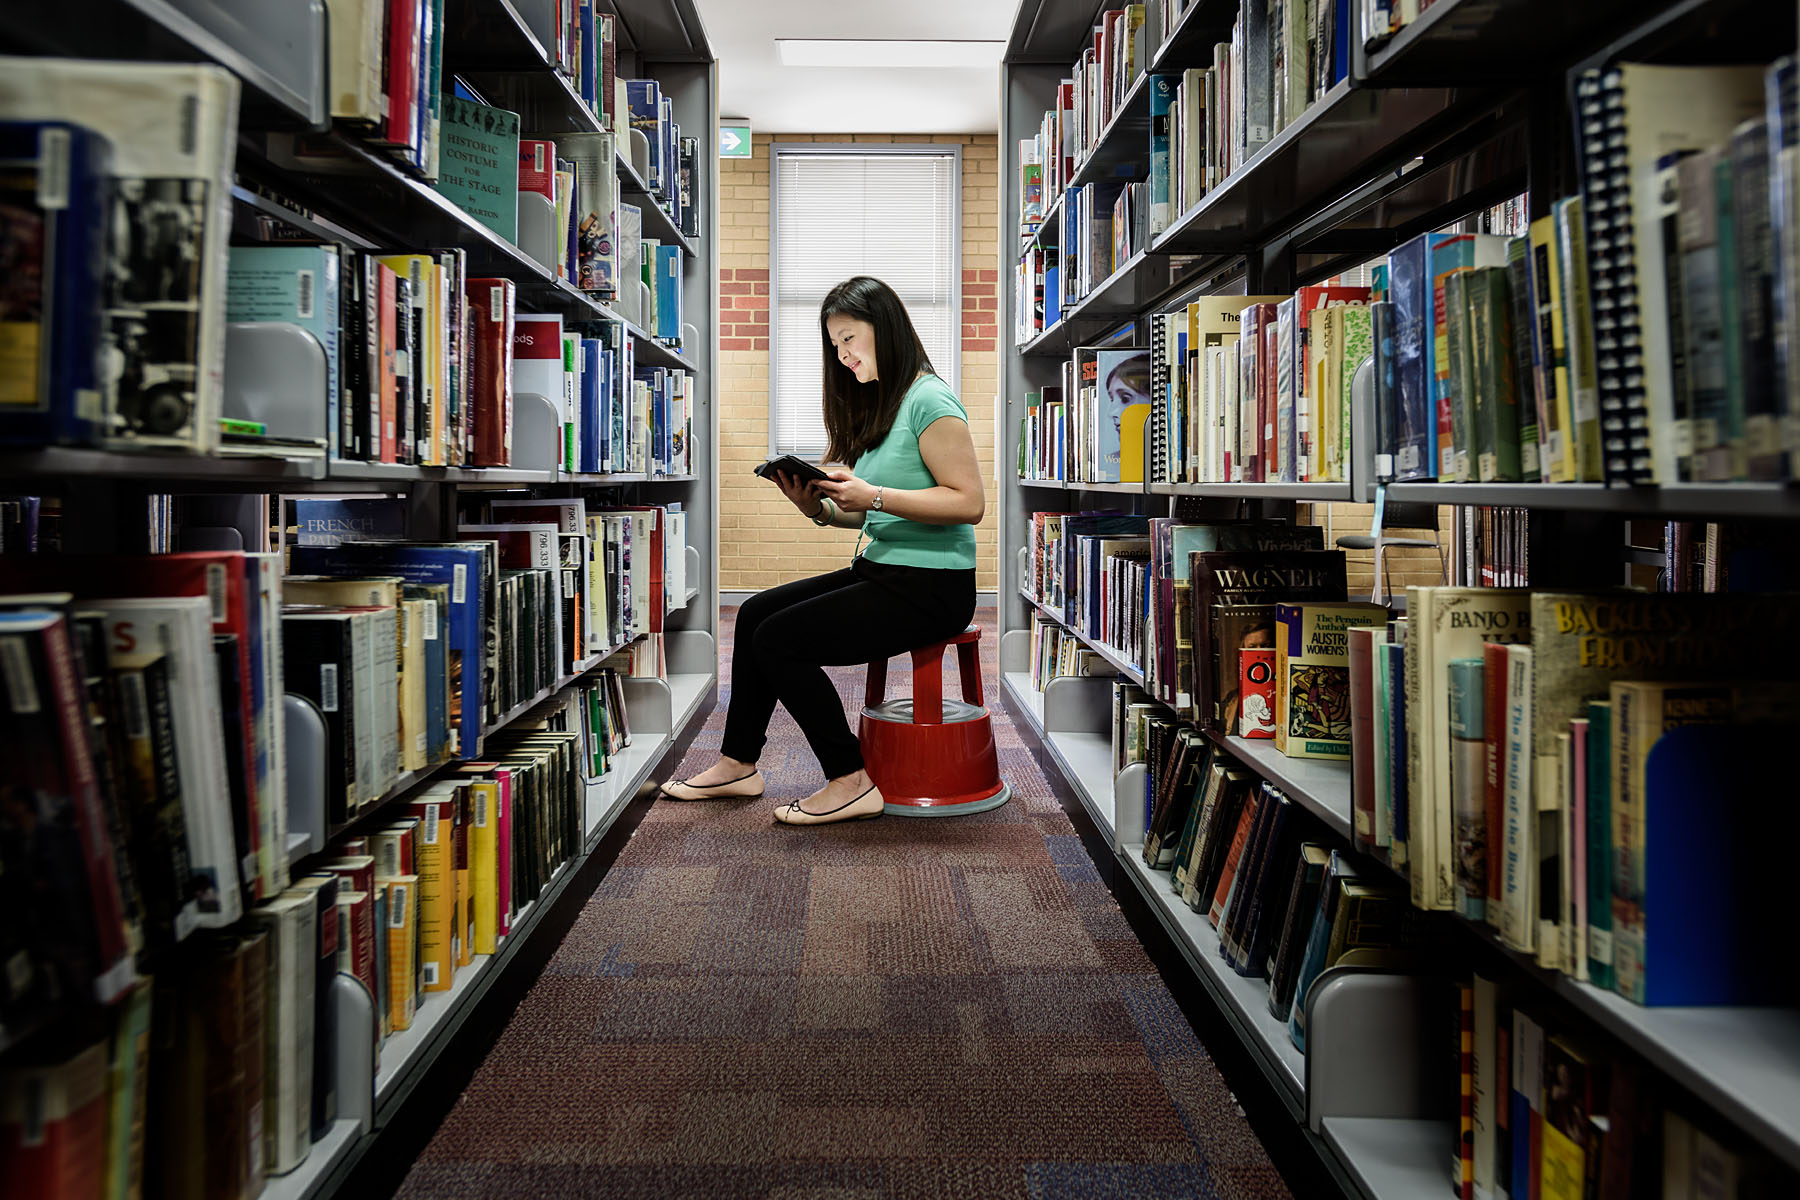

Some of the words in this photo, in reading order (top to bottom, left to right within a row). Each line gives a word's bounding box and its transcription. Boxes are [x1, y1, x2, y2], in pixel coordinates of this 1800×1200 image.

[447, 133, 499, 155] HISTORIC
[446, 148, 499, 169] COSTUME
[464, 166, 480, 177] FOR
[442, 173, 465, 187] THE
[468, 179, 502, 196] STAGE
[467, 206, 499, 219] BARTON
[1221, 313, 1240, 322] The
[1082, 361, 1098, 381] SC
[1104, 454, 1121, 464] Wo
[307, 518, 375, 532] FRENCH
[539, 533, 549, 567] 796.333
[1214, 569, 1323, 588] WAGNER
[1315, 614, 1334, 623] The
[1335, 615, 1373, 627] Penguin
[1451, 611, 1511, 630] BANJO
[1556, 600, 1694, 634] BACKLESS
[1306, 644, 1345, 656] WOMEN'S
[1579, 634, 1665, 669] FROM
[1246, 661, 1276, 684] O
[1513, 704, 1523, 736] The
[1509, 742, 1522, 791] Banjo
[1509, 796, 1519, 814] of
[1508, 818, 1518, 846] the
